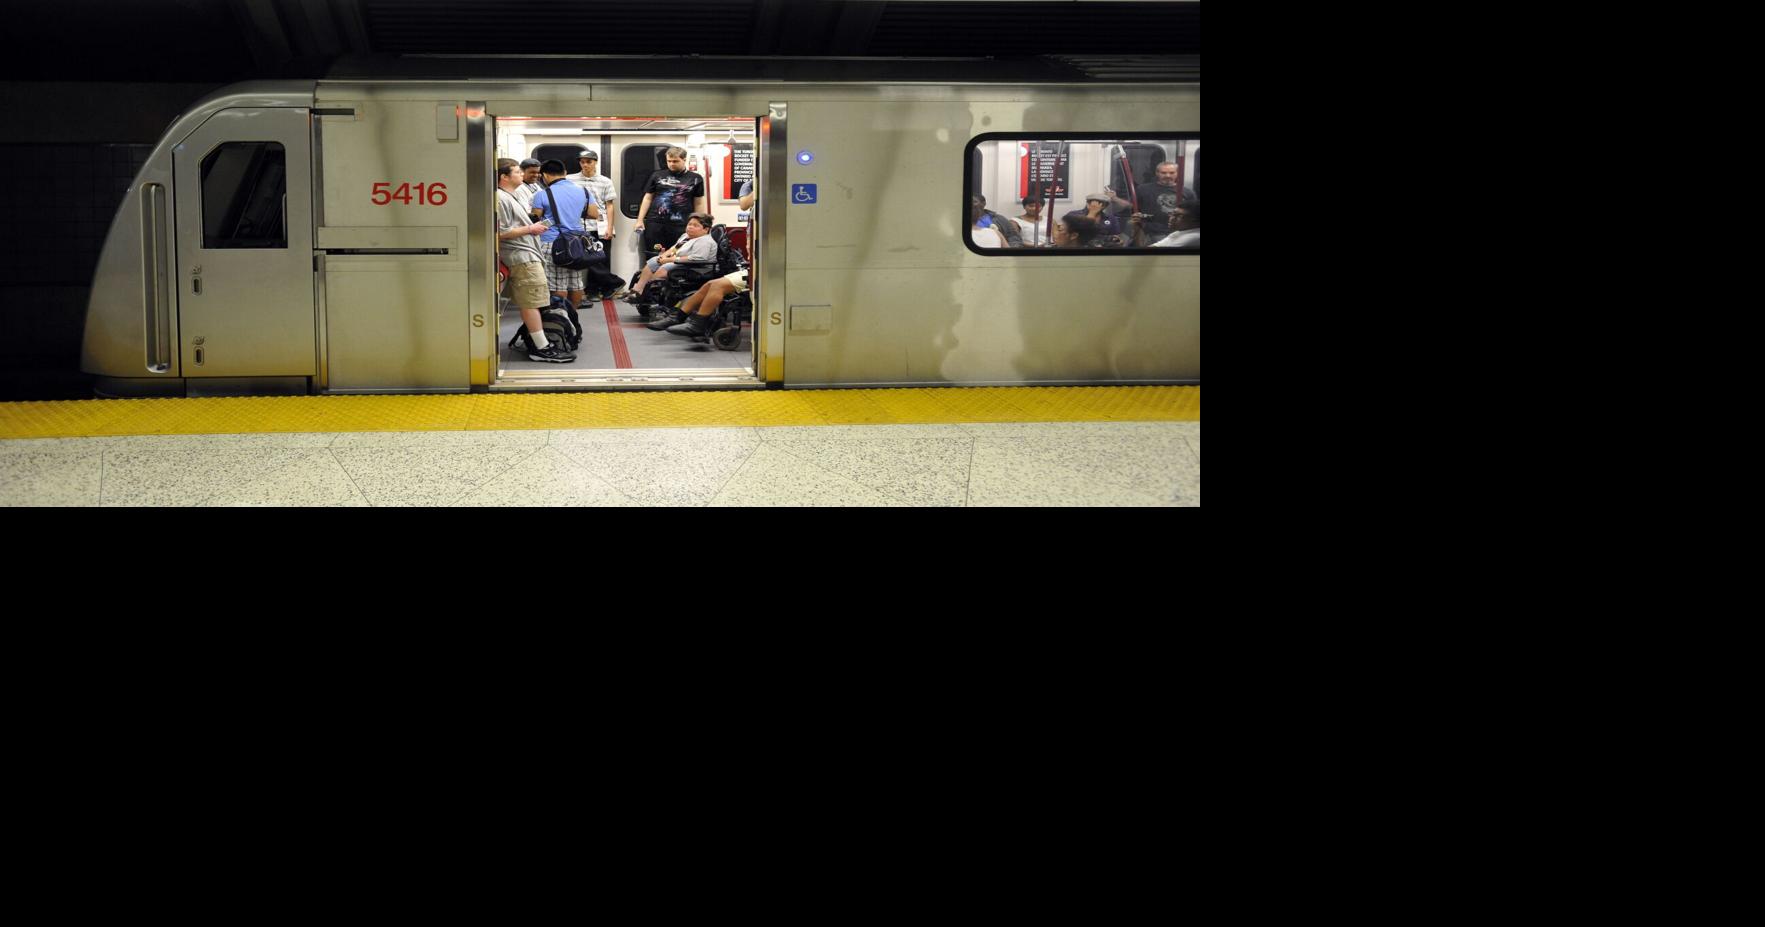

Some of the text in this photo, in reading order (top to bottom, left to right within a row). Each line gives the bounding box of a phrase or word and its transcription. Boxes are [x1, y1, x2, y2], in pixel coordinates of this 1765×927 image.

[371, 182, 448, 206] 5416
[472, 314, 484, 328] S
[770, 312, 781, 325] S
